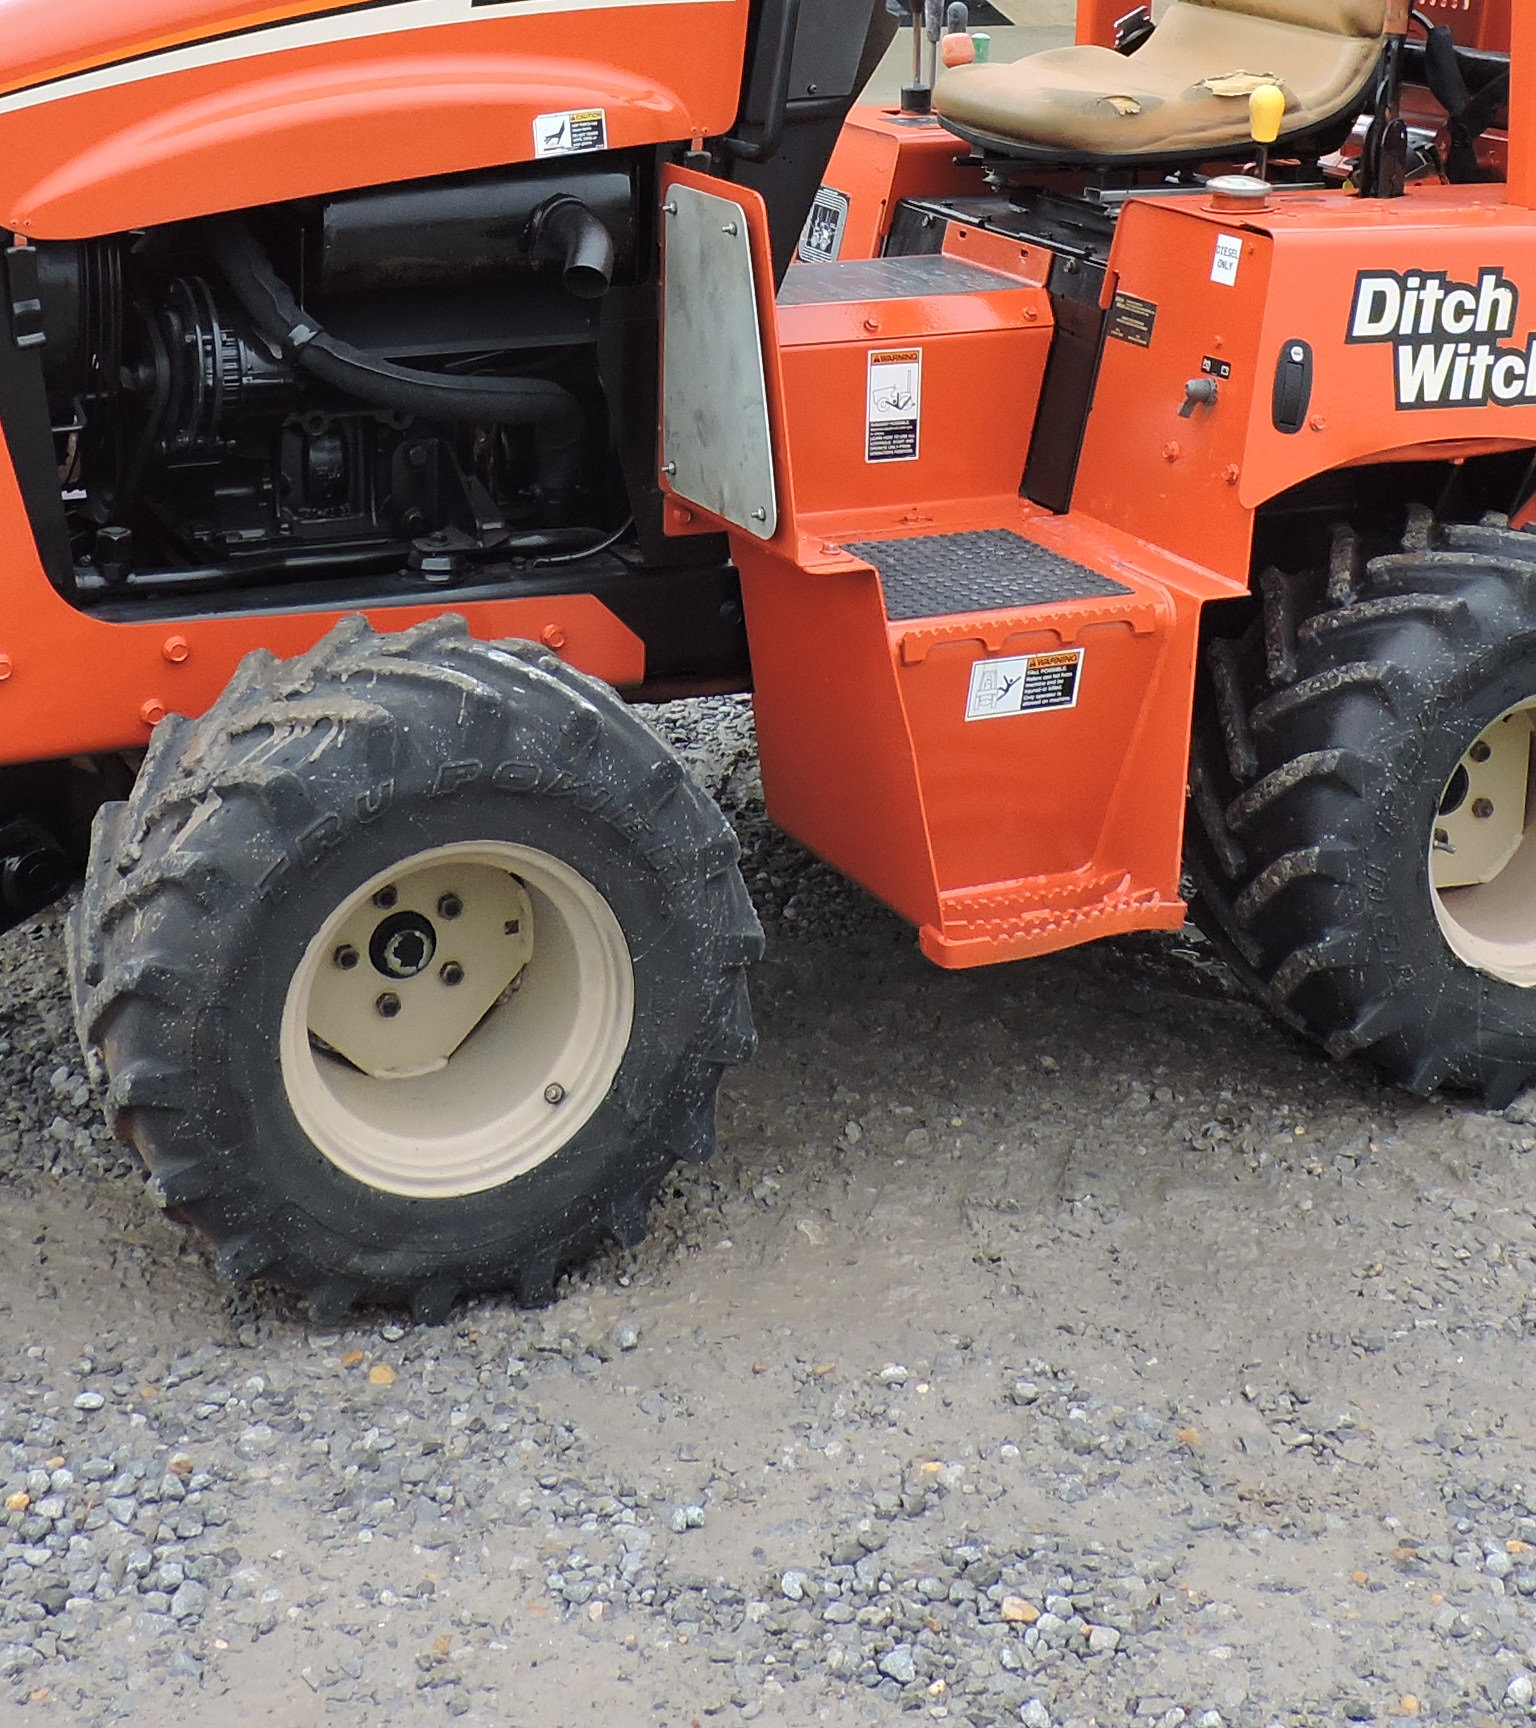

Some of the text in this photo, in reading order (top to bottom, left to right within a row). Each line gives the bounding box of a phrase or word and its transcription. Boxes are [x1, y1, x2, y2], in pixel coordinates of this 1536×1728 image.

[1215, 245, 1239, 260] DIESEL
[1217, 258, 1233, 271] ONLY
[1352, 275, 1513, 336] Ditch
[1038, 654, 1077, 666] WARNING
